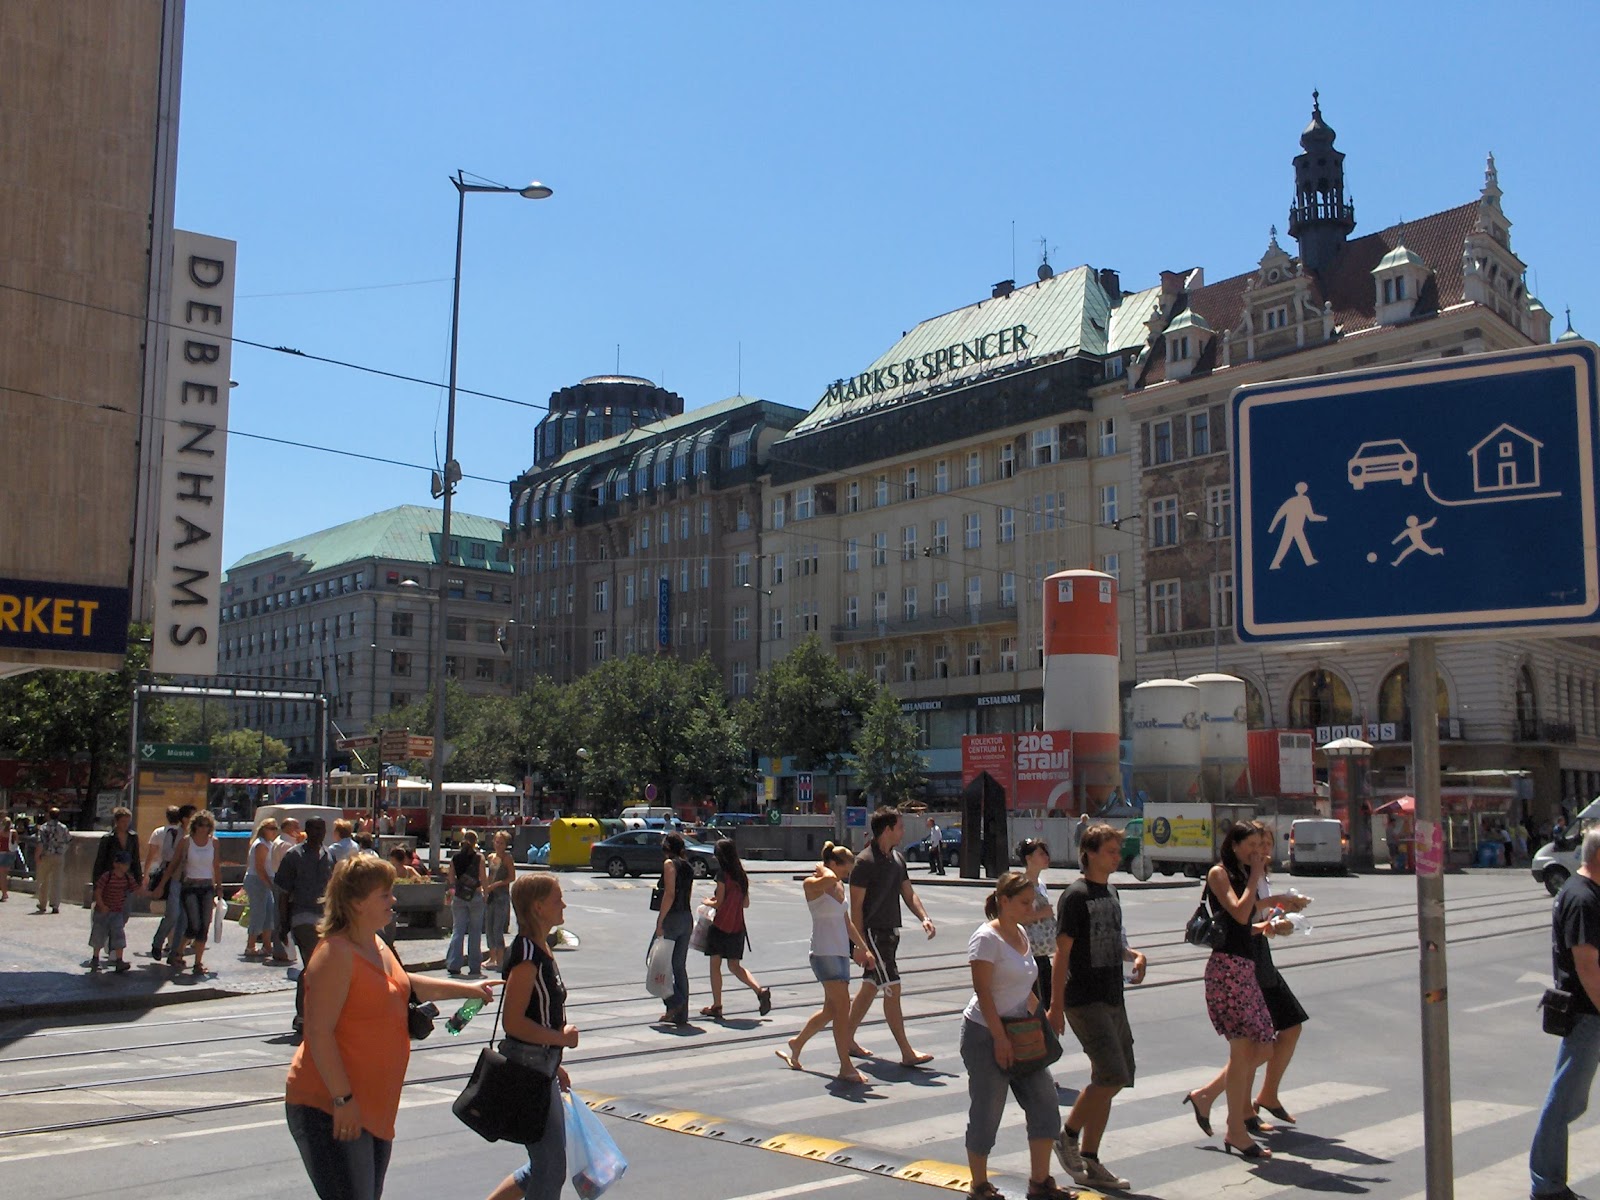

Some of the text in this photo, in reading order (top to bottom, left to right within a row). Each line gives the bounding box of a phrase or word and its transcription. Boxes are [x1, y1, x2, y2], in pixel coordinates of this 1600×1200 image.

[170, 255, 225, 647] DEBENHAMS
[0, 594, 98, 636] RKET
[660, 582, 669, 645] ROKOKO
[977, 694, 1021, 706] RESTAURANT
[970, 736, 1003, 745] KOLEKTOR
[1319, 726, 1393, 742] BOOKS
[968, 745, 997, 754] CENTRUM
